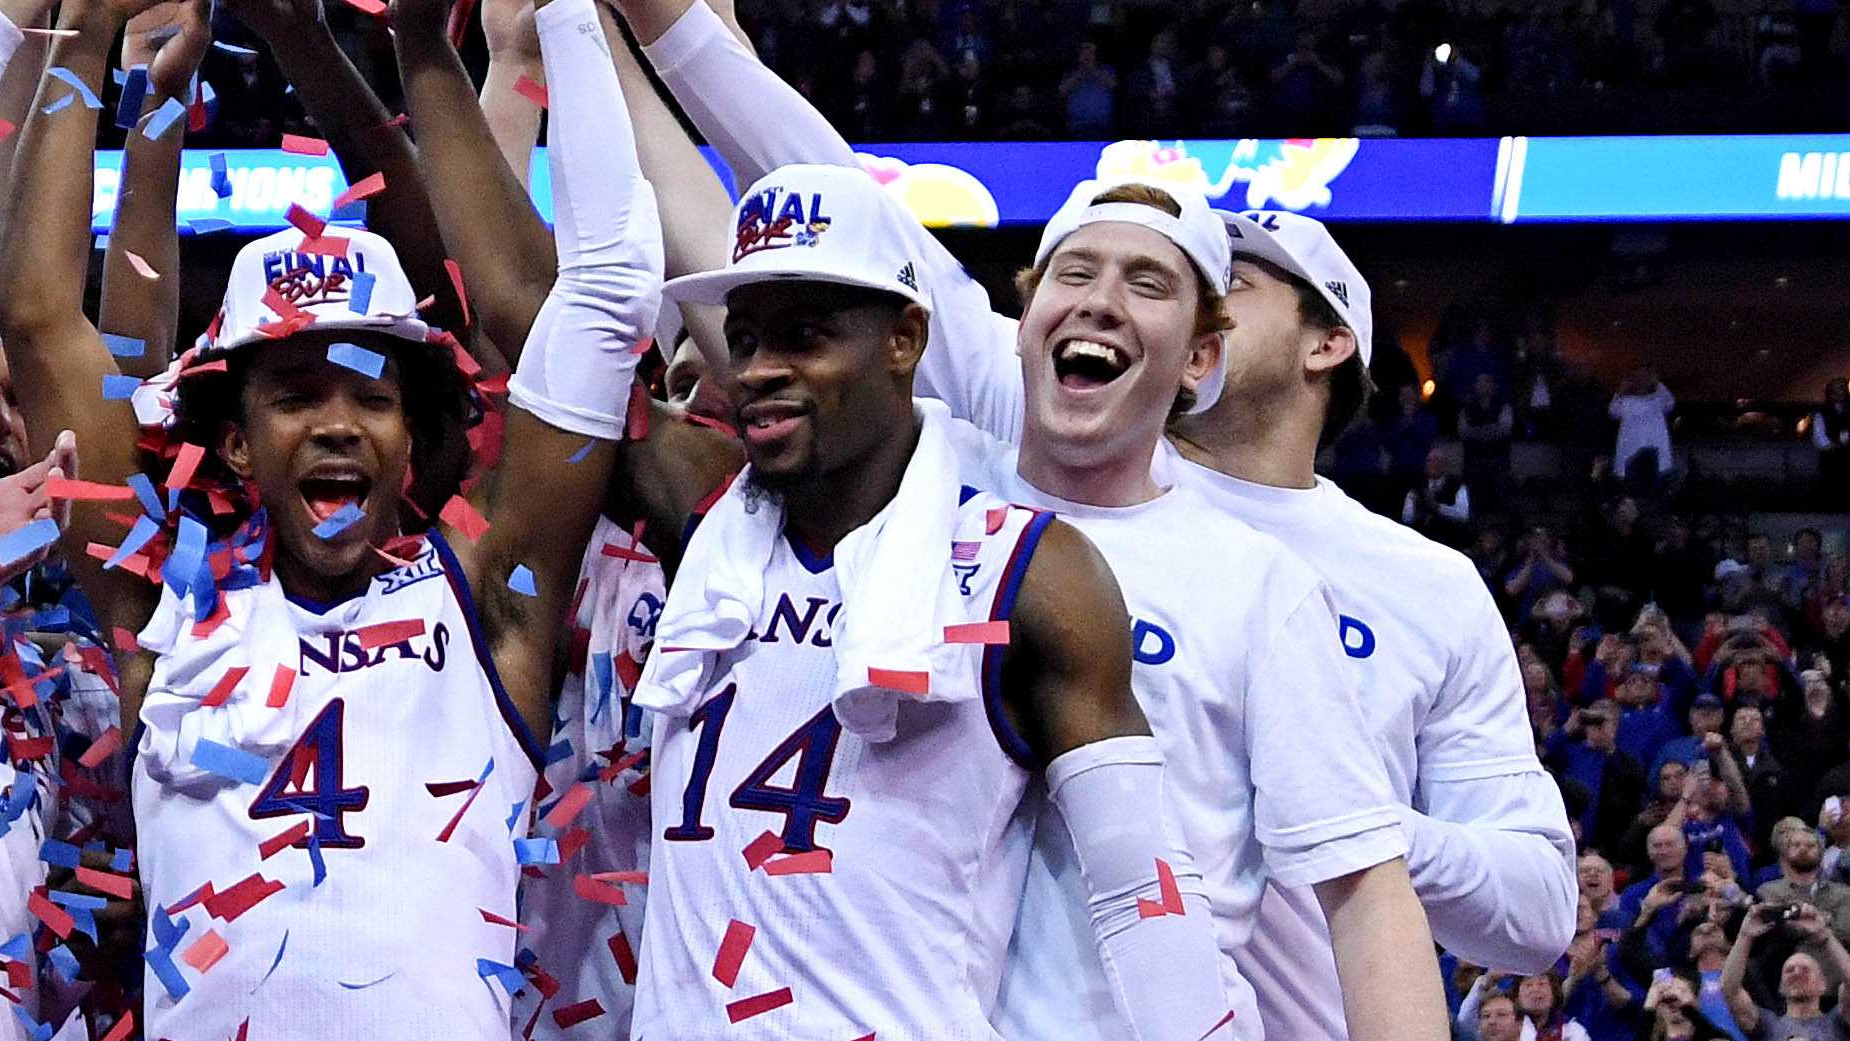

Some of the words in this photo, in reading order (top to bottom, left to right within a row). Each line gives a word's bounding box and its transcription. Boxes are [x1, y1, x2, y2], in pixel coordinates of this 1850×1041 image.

[738, 191, 831, 228] NAL
[249, 697, 369, 849] 4
[663, 683, 851, 853] 14
